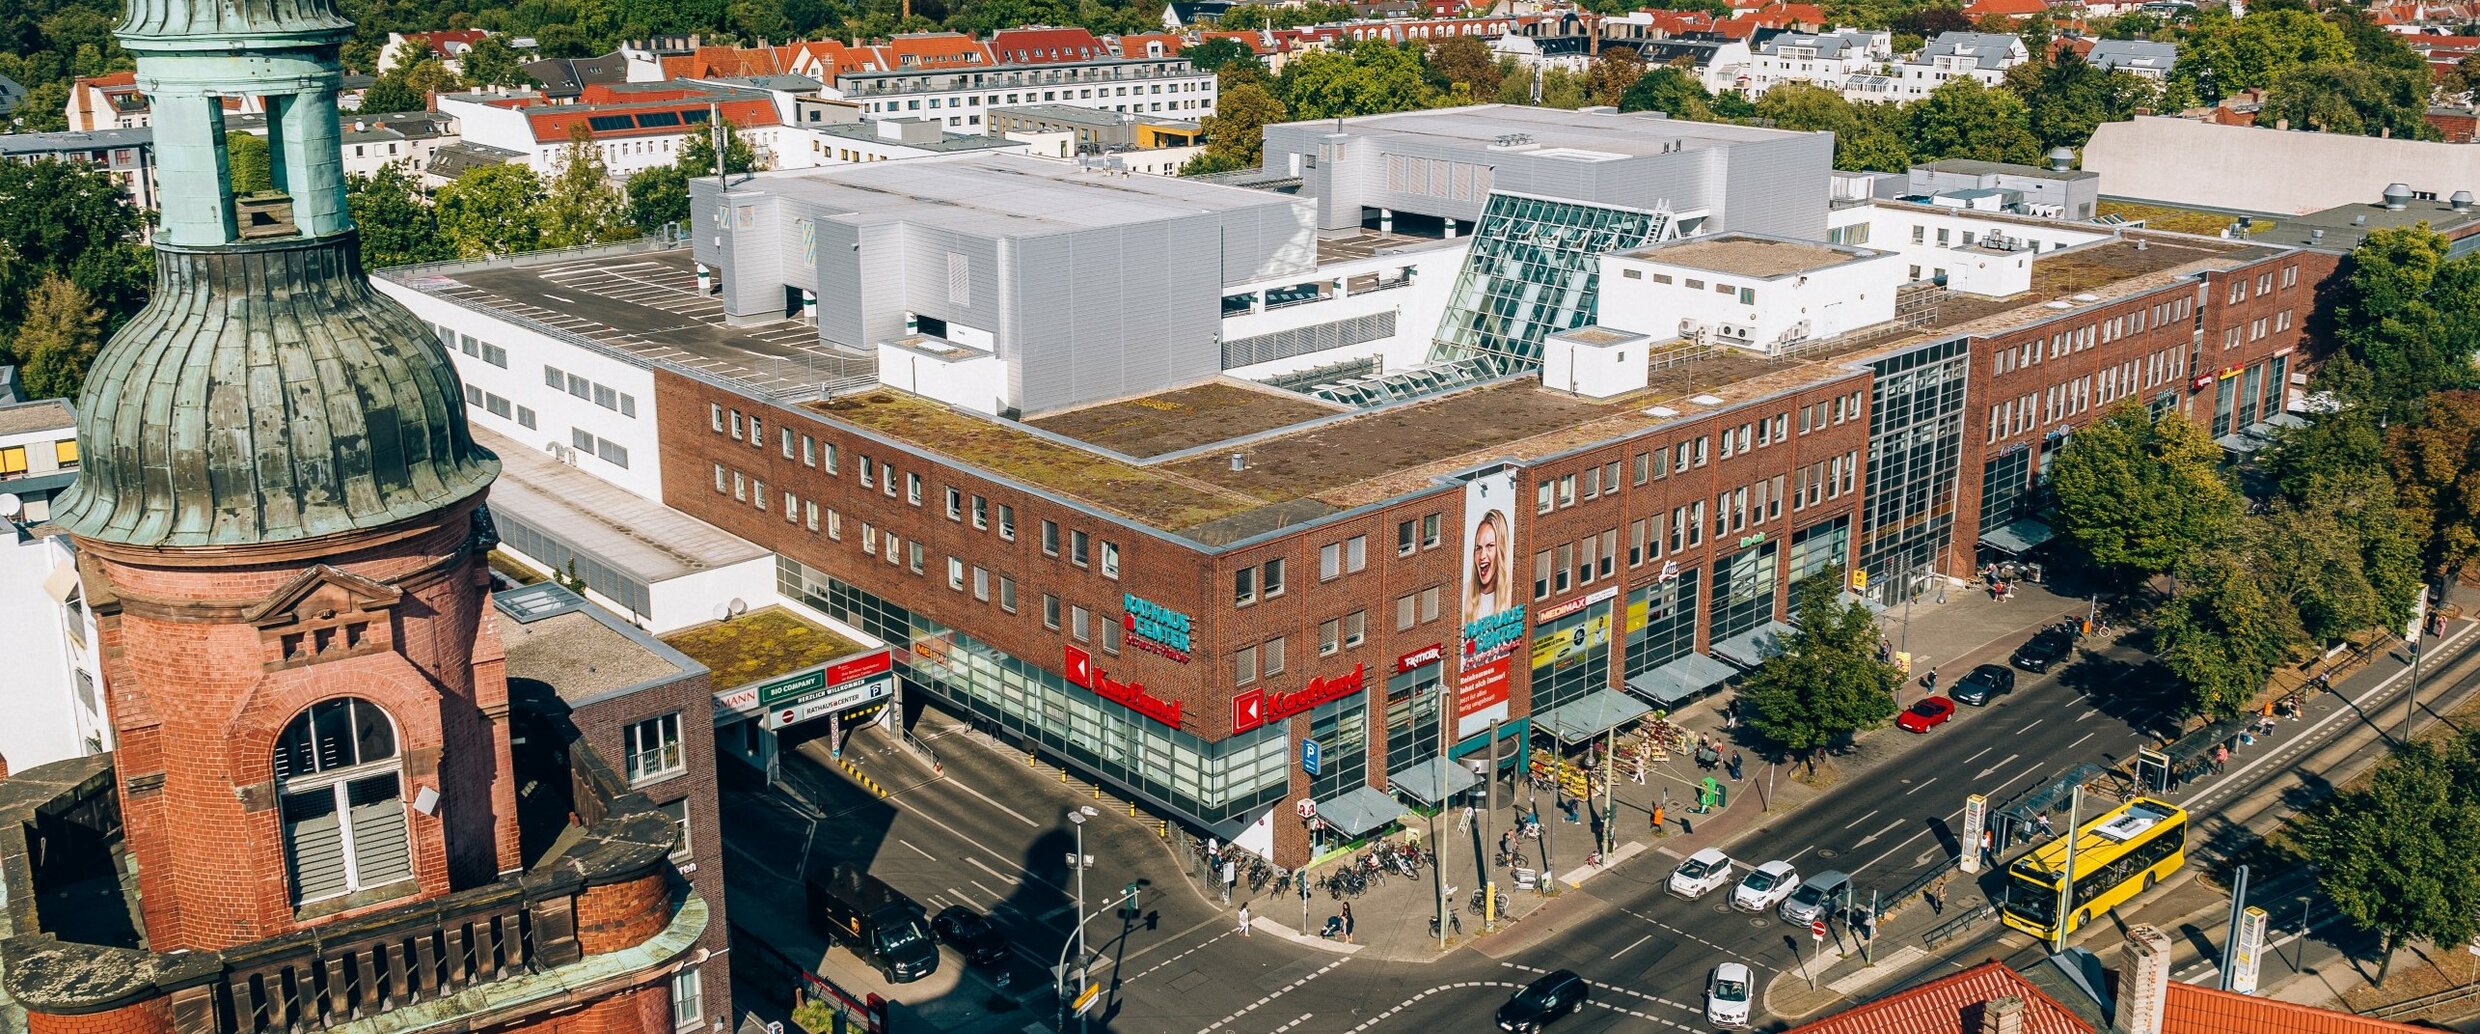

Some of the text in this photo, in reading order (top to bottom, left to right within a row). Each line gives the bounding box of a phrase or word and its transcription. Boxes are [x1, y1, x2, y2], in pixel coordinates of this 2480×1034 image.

[1123, 592, 1190, 633] RATHAUS
[1465, 603, 1525, 638] RATHAUS
[1541, 599, 1586, 621] MEDIMAX
[1135, 616, 1190, 653] CENTER
[1476, 621, 1524, 652] CENTER
[770, 677, 816, 696] BIO COMPANY
[1460, 667, 1495, 685] Reinkommen
[1460, 684, 1475, 695] lohnt
[1475, 679, 1487, 689] sich
[713, 690, 756, 711] SMANN
[797, 679, 865, 704] HERZLICH WILLKOMMEN
[1094, 665, 1181, 726] Kaufland
[1267, 662, 1363, 720] Kaufland
[806, 694, 860, 715] RATHAUS CENTER
[1306, 746, 1315, 758] P
[678, 862, 697, 876] ren
